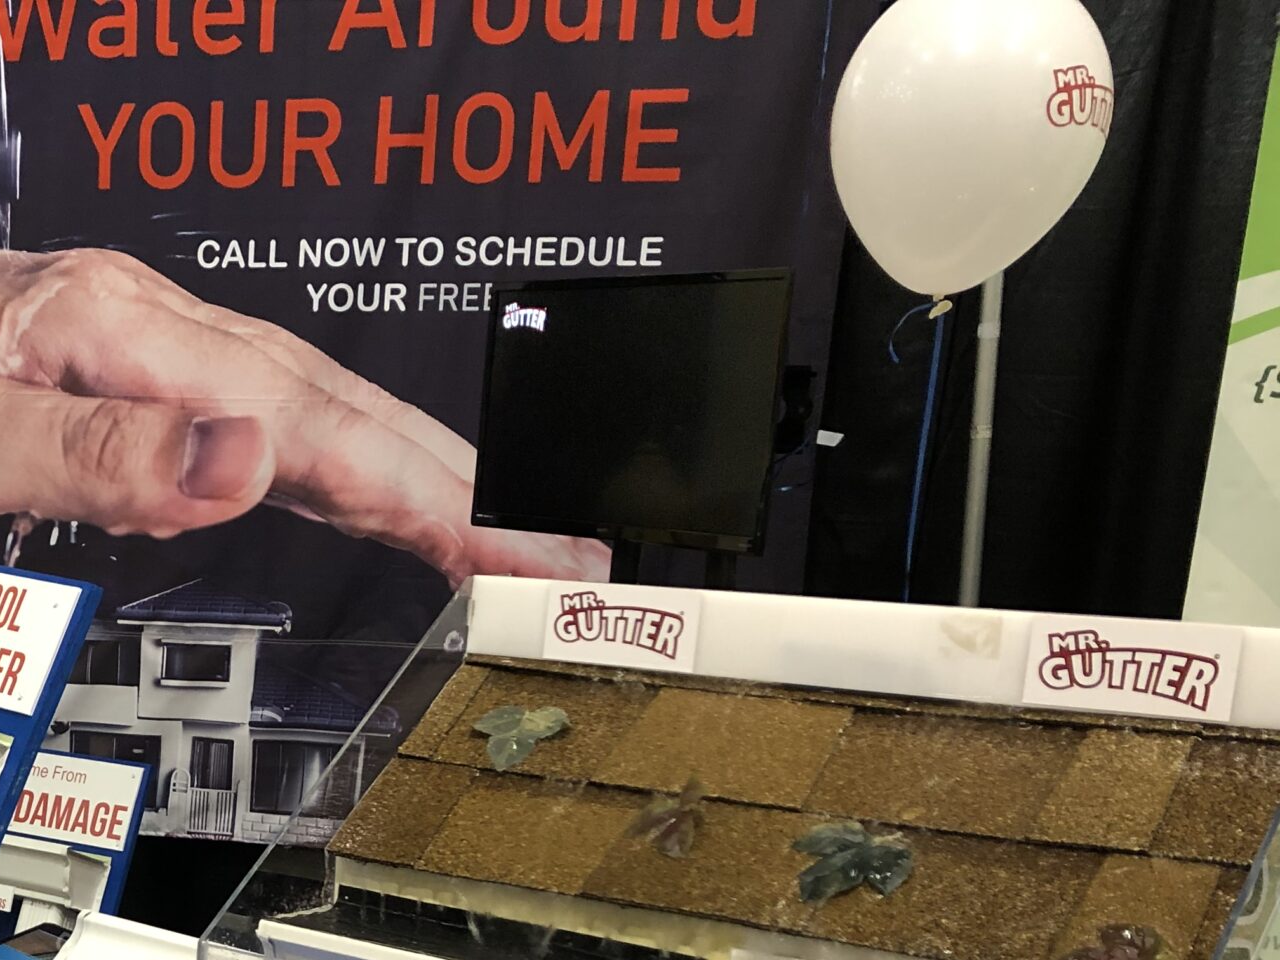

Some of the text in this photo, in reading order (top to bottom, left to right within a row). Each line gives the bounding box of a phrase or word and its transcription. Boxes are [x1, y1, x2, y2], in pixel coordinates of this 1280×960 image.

[1053, 65, 1095, 88] MR.
[78, 89, 689, 190] YOUR HOME
[197, 236, 664, 268] CALL NOW TO SCHEDULE
[307, 283, 406, 312] YOUR
[503, 308, 547, 331] GUTTER
[562, 592, 605, 612] MR.
[555, 607, 684, 659] GUTTER
[1049, 630, 1110, 654] MR.
[1039, 649, 1219, 711] GUTTER
[52, 765, 87, 784] From
[13, 789, 128, 841] DAMAGE
